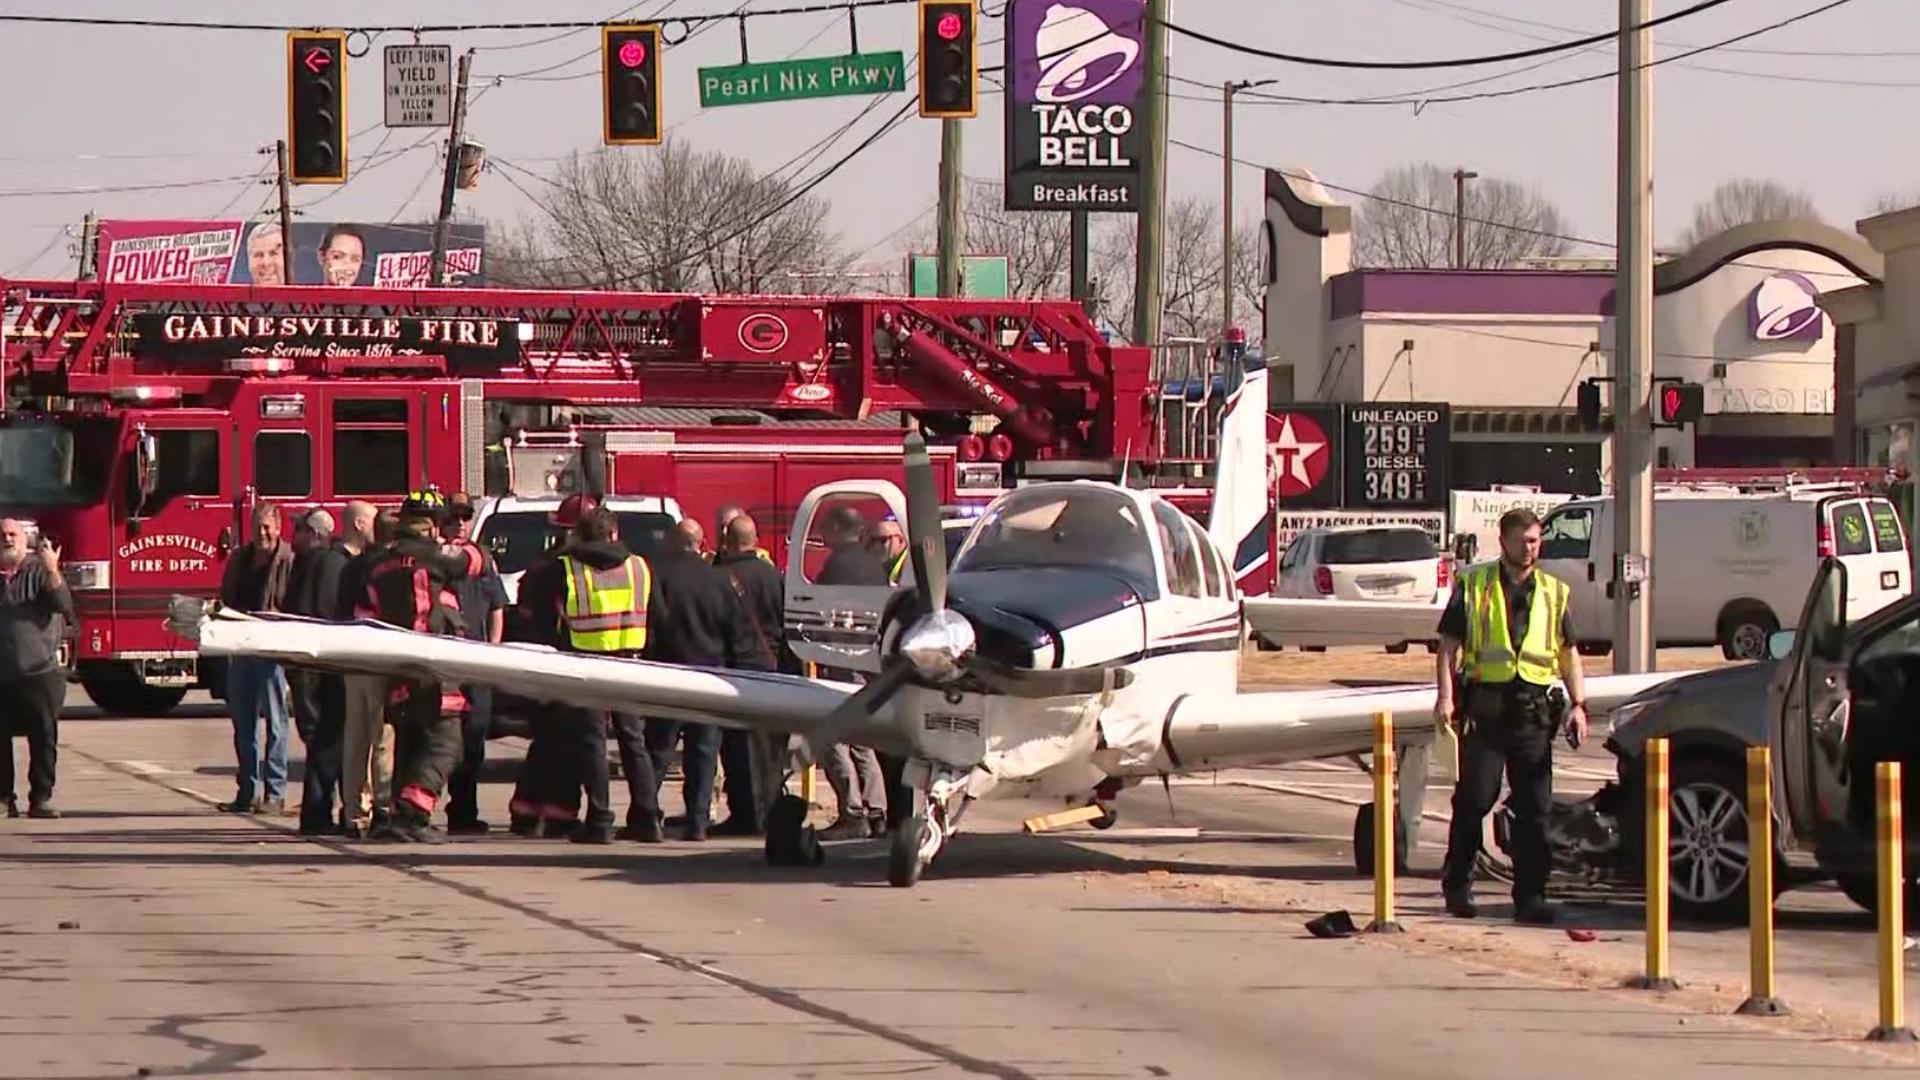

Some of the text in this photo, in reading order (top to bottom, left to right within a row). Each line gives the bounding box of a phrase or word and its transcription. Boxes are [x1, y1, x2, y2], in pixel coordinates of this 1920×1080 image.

[389, 49, 445, 64] LEFT TURN
[398, 67, 436, 81] YIELD
[705, 65, 896, 98] Pearl Nix Pkwy
[388, 84, 447, 96] ON FLASHING
[401, 99, 434, 109] YELLOW
[402, 111, 433, 122] ARROW
[1031, 104, 1133, 135] TACO
[1040, 136, 1131, 166] BELL
[1033, 184, 1128, 202] Breakfast
[111, 248, 190, 281] POWER
[380, 258, 393, 278] EL
[164, 315, 499, 347] GAINESVILLE FIRE
[364, 343, 393, 357] 1876
[1711, 387, 1795, 413] TACO
[1352, 410, 1439, 422] UNLEADED
[1364, 426, 1410, 454] 259
[1366, 456, 1424, 469] DIESEL
[1365, 472, 1410, 500] 349
[119, 535, 217, 558] GAINESVILLE
[131, 559, 208, 572] FIRE DEPT.
